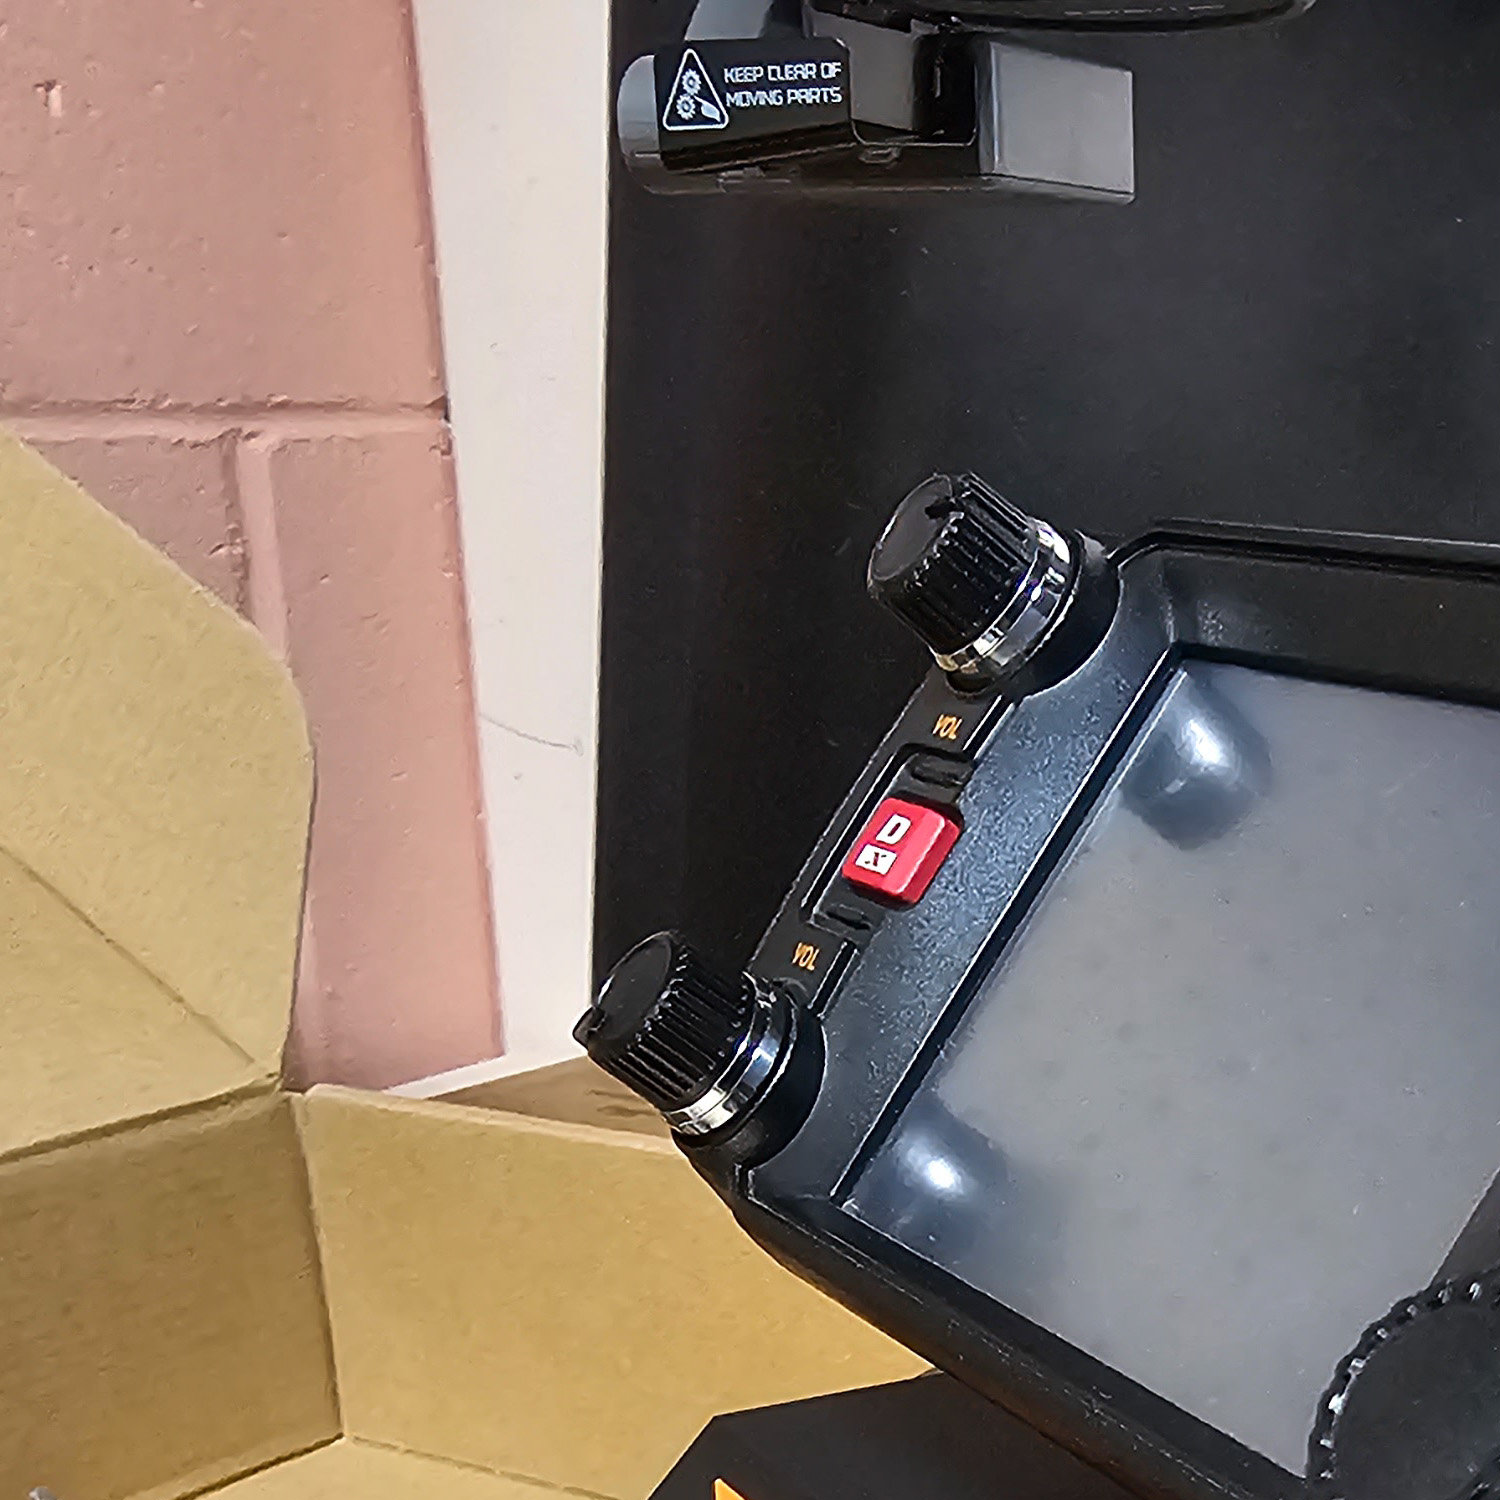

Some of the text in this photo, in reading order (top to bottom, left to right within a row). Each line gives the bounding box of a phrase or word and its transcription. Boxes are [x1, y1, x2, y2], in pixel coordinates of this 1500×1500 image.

[723, 61, 842, 83] KEEP CLEAR OF
[725, 86, 842, 107] MOVING PARTS
[932, 714, 963, 740] VOL
[875, 813, 912, 845] D
[791, 942, 820, 971] VOL
